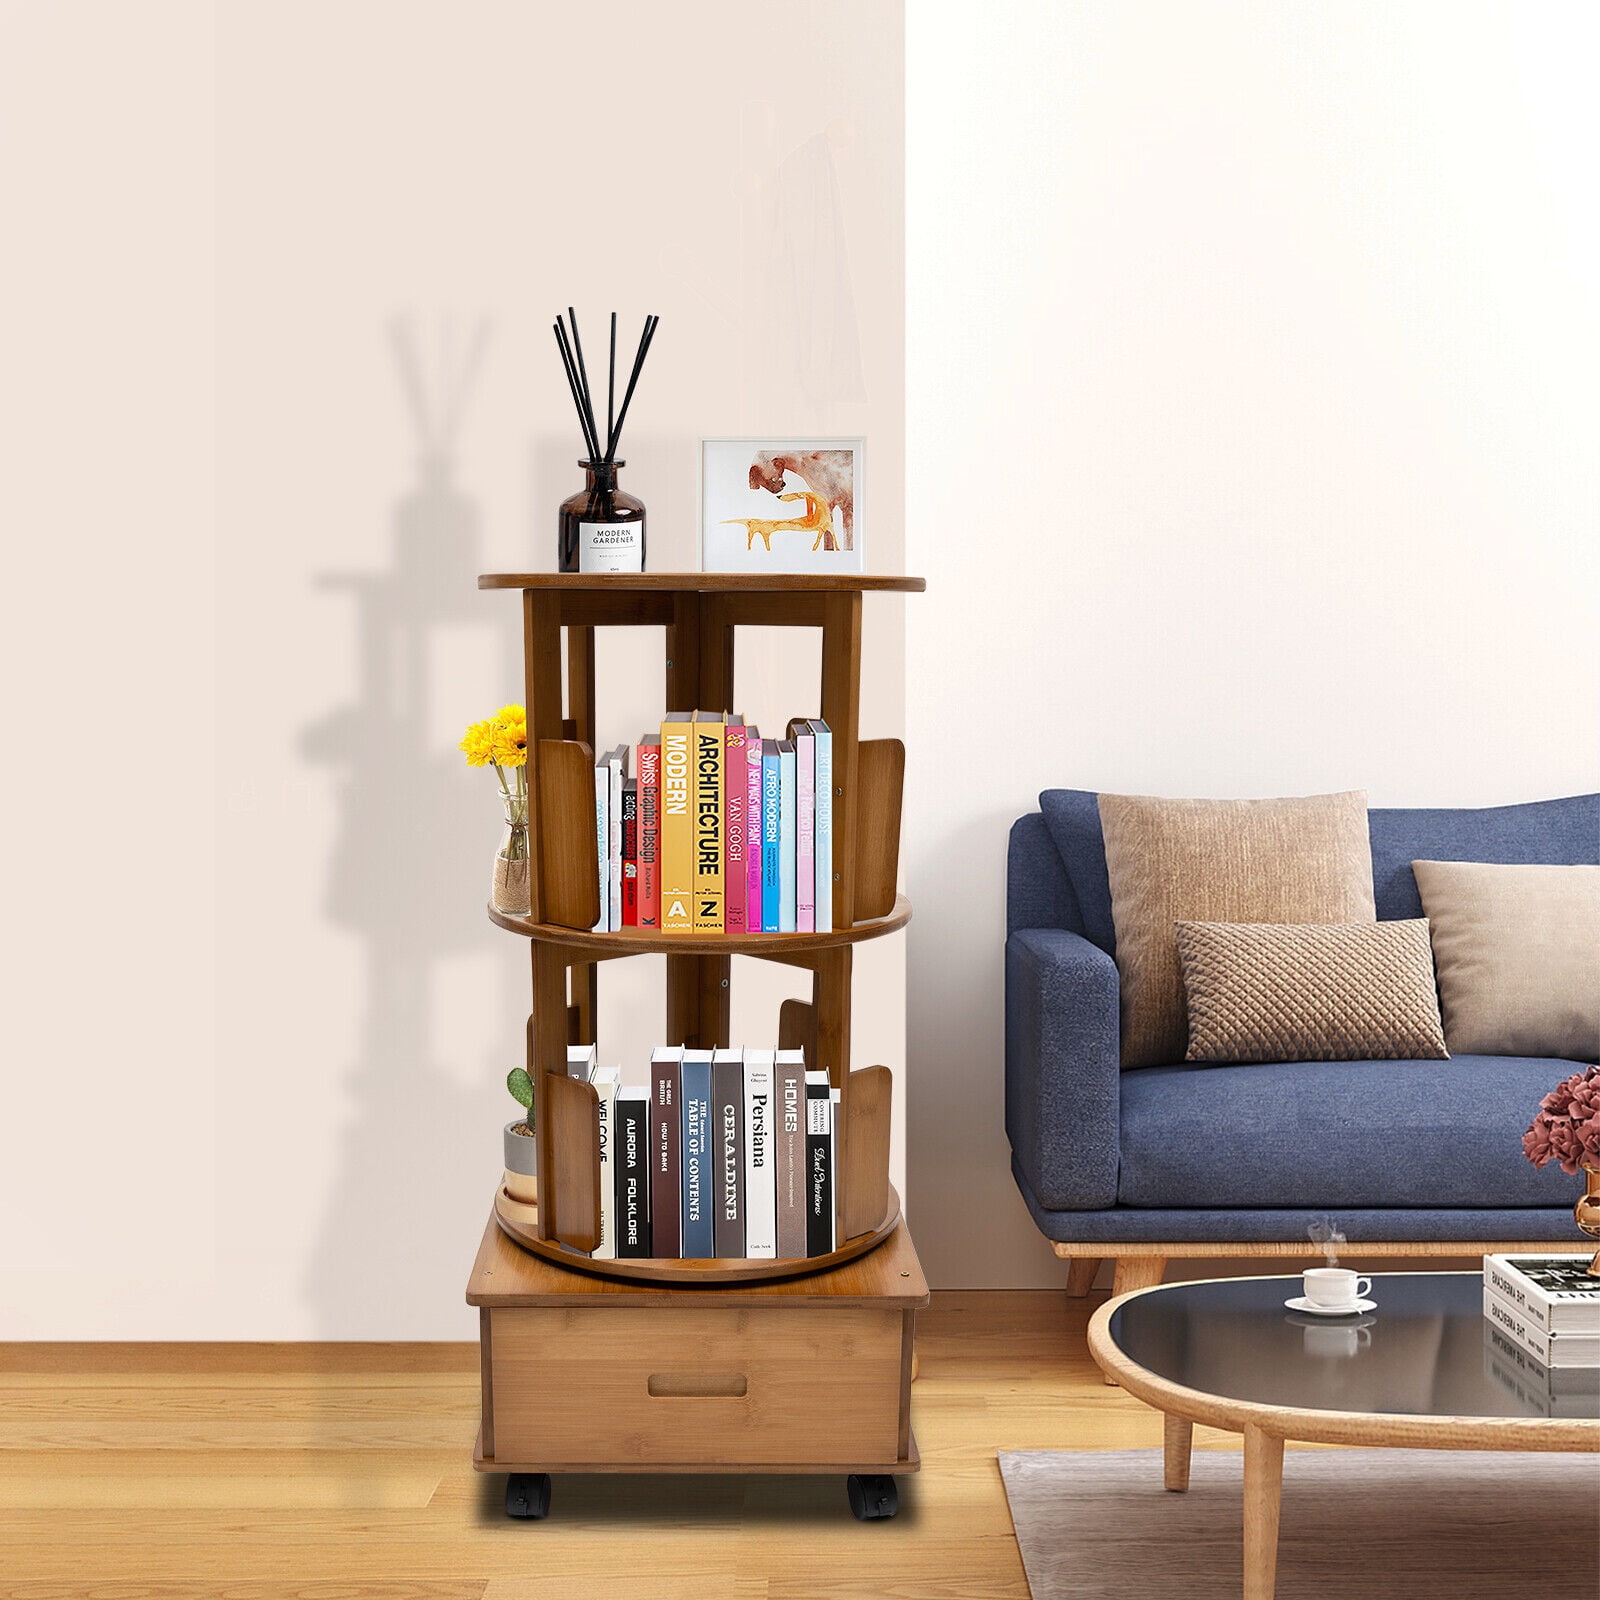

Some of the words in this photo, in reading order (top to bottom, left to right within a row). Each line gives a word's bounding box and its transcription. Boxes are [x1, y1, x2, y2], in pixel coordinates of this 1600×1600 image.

[592, 536, 634, 544] GARDENER
[642, 752, 659, 783] Swiss
[665, 734, 688, 816] MODERN
[748, 768, 760, 785] NEW
[818, 751, 830, 769] ART
[766, 769, 778, 796] AFRO
[818, 773, 830, 799] DECO
[623, 795, 637, 820] acting
[640, 786, 658, 826] Graphic
[698, 734, 721, 876] ARCHITECTURE
[729, 796, 742, 821] VAN
[766, 799, 778, 842] MODERN
[818, 801, 831, 835] HOUSE
[640, 828, 658, 863] Design
[729, 825, 742, 862] GOGH
[667, 900, 688, 918] A
[700, 901, 718, 917] Z
[688, 1098, 699, 1136] TABLE
[784, 1078, 798, 1132] HOMES
[626, 1118, 636, 1168] AURORA
[661, 1141, 668, 1151] TO
[689, 1138, 699, 1155] OF
[752, 1094, 768, 1168] Persiana
[689, 1157, 700, 1221] CONTENTS
[626, 1178, 637, 1245] FOLKLORE
